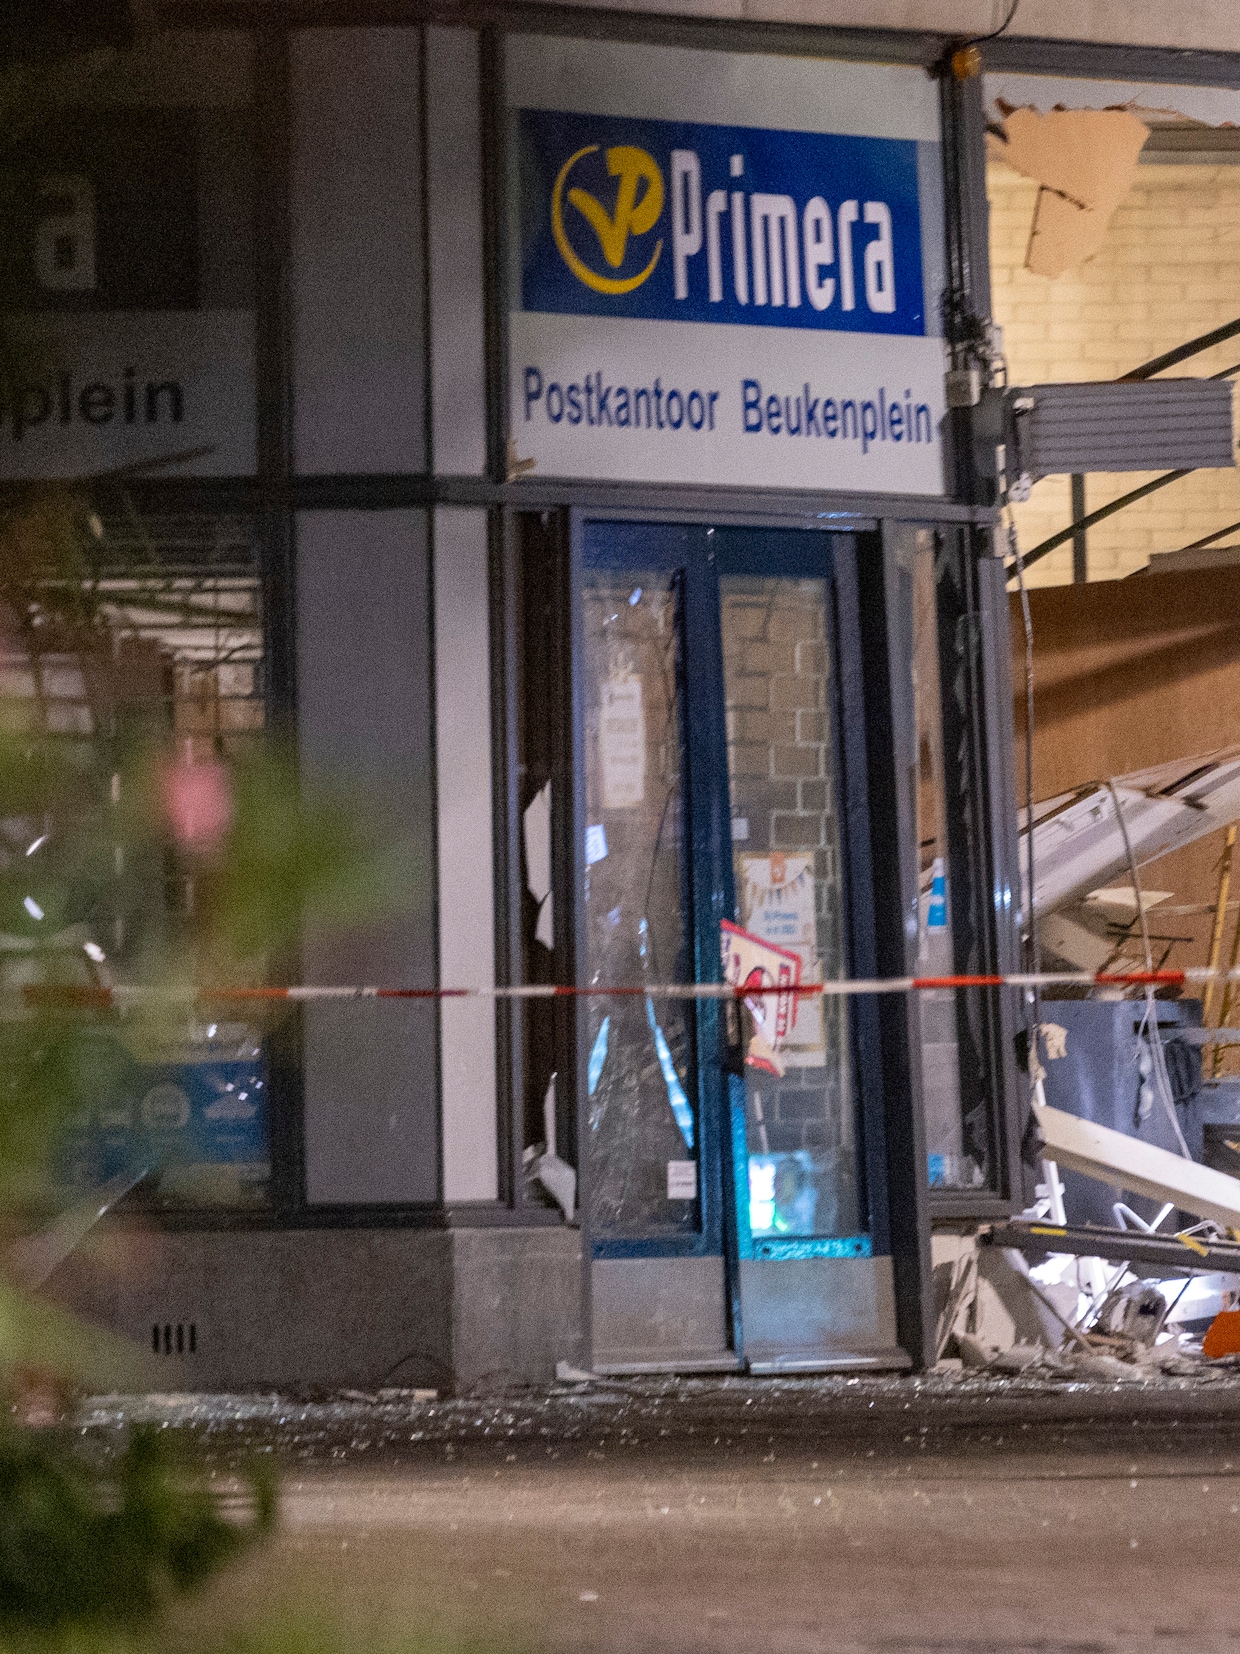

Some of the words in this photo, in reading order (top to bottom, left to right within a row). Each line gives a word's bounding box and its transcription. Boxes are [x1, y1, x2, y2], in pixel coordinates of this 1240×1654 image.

[670, 149, 896, 313] Primera
[0, 367, 184, 440] plein
[523, 366, 720, 431] Postkantoor
[741, 378, 933, 454] Beukenplein
